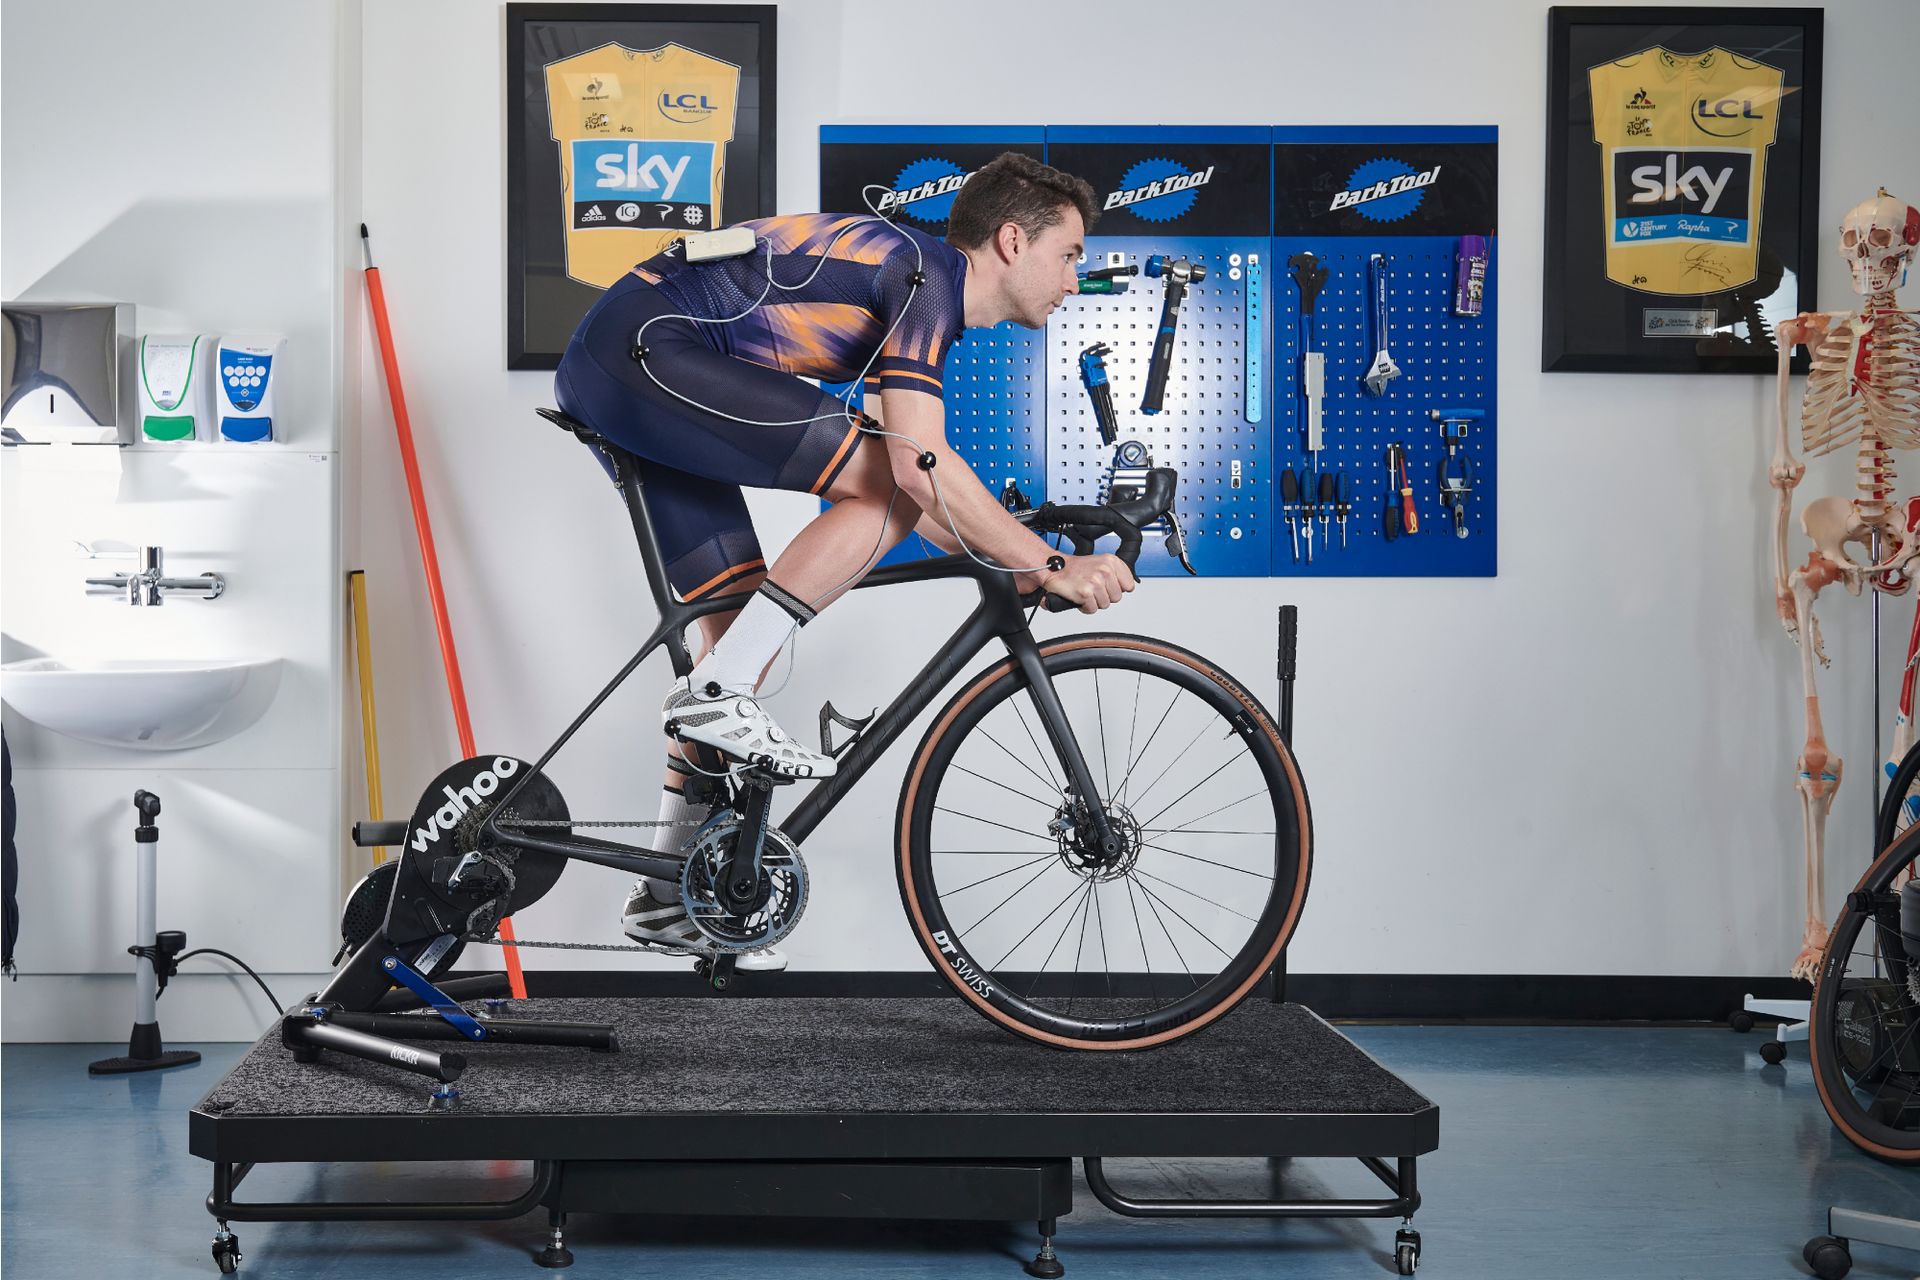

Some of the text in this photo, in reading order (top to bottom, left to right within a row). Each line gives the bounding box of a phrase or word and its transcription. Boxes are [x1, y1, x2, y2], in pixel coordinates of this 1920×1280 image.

[663, 93, 718, 110] LCL
[1698, 98, 1764, 120] LCL
[595, 143, 692, 200] sky
[1103, 165, 1215, 211] ParkTool
[1329, 165, 1442, 211] ParkTool
[1631, 154, 1734, 214] sky
[581, 214, 607, 222] adidas
[1677, 219, 1711, 235] Rapha
[411, 756, 519, 853] wahoo
[932, 930, 994, 999] DT SWISS
[390, 1045, 421, 1065] KICKR
